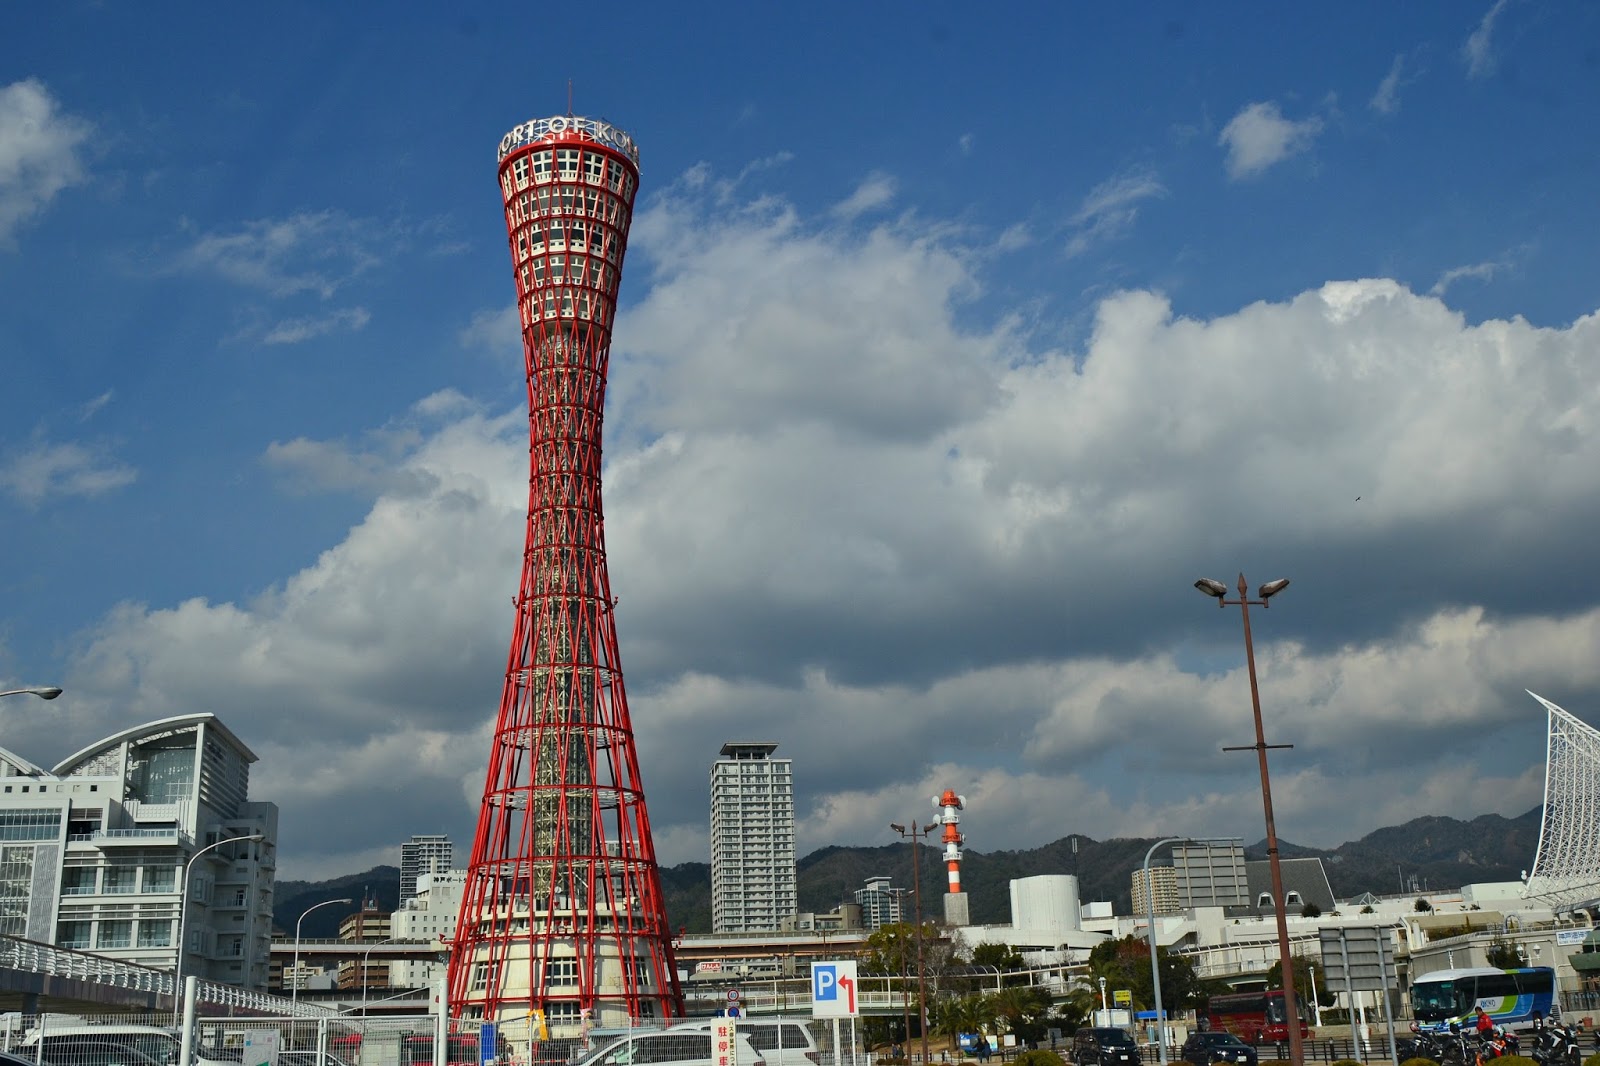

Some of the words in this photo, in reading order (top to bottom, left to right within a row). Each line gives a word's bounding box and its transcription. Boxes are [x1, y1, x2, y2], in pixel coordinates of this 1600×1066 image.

[548, 115, 586, 134] OF
[597, 120, 639, 165] KO
[818, 971, 834, 996] P
[717, 1026, 728, 1066] 駐停車
